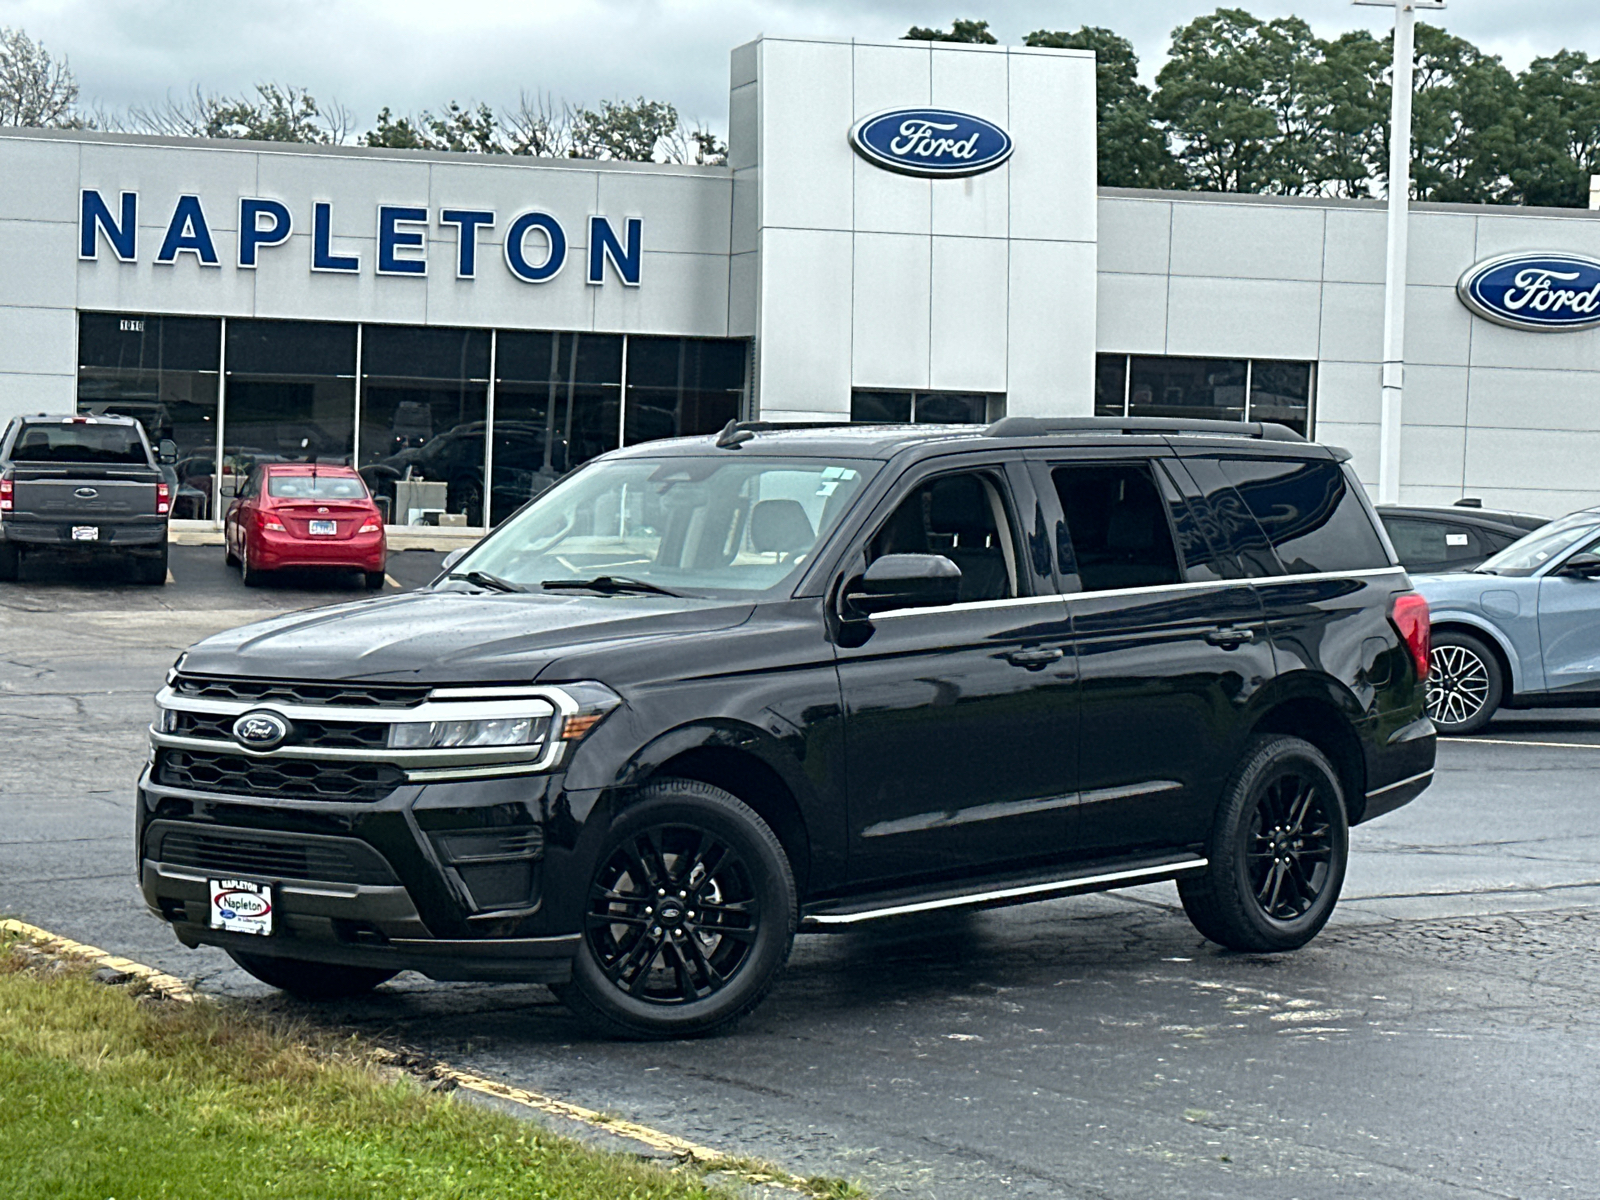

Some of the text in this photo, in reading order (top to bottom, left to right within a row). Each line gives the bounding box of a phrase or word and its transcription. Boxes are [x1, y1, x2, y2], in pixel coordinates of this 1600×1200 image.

[890, 119, 980, 159] Ford
[78, 187, 644, 288] NAPLETON
[1503, 268, 1600, 313] Ford
[120, 319, 144, 332] 1010
[242, 719, 273, 738] Ford
[221, 880, 258, 893] NAPLETON
[223, 894, 263, 912] Napleton
